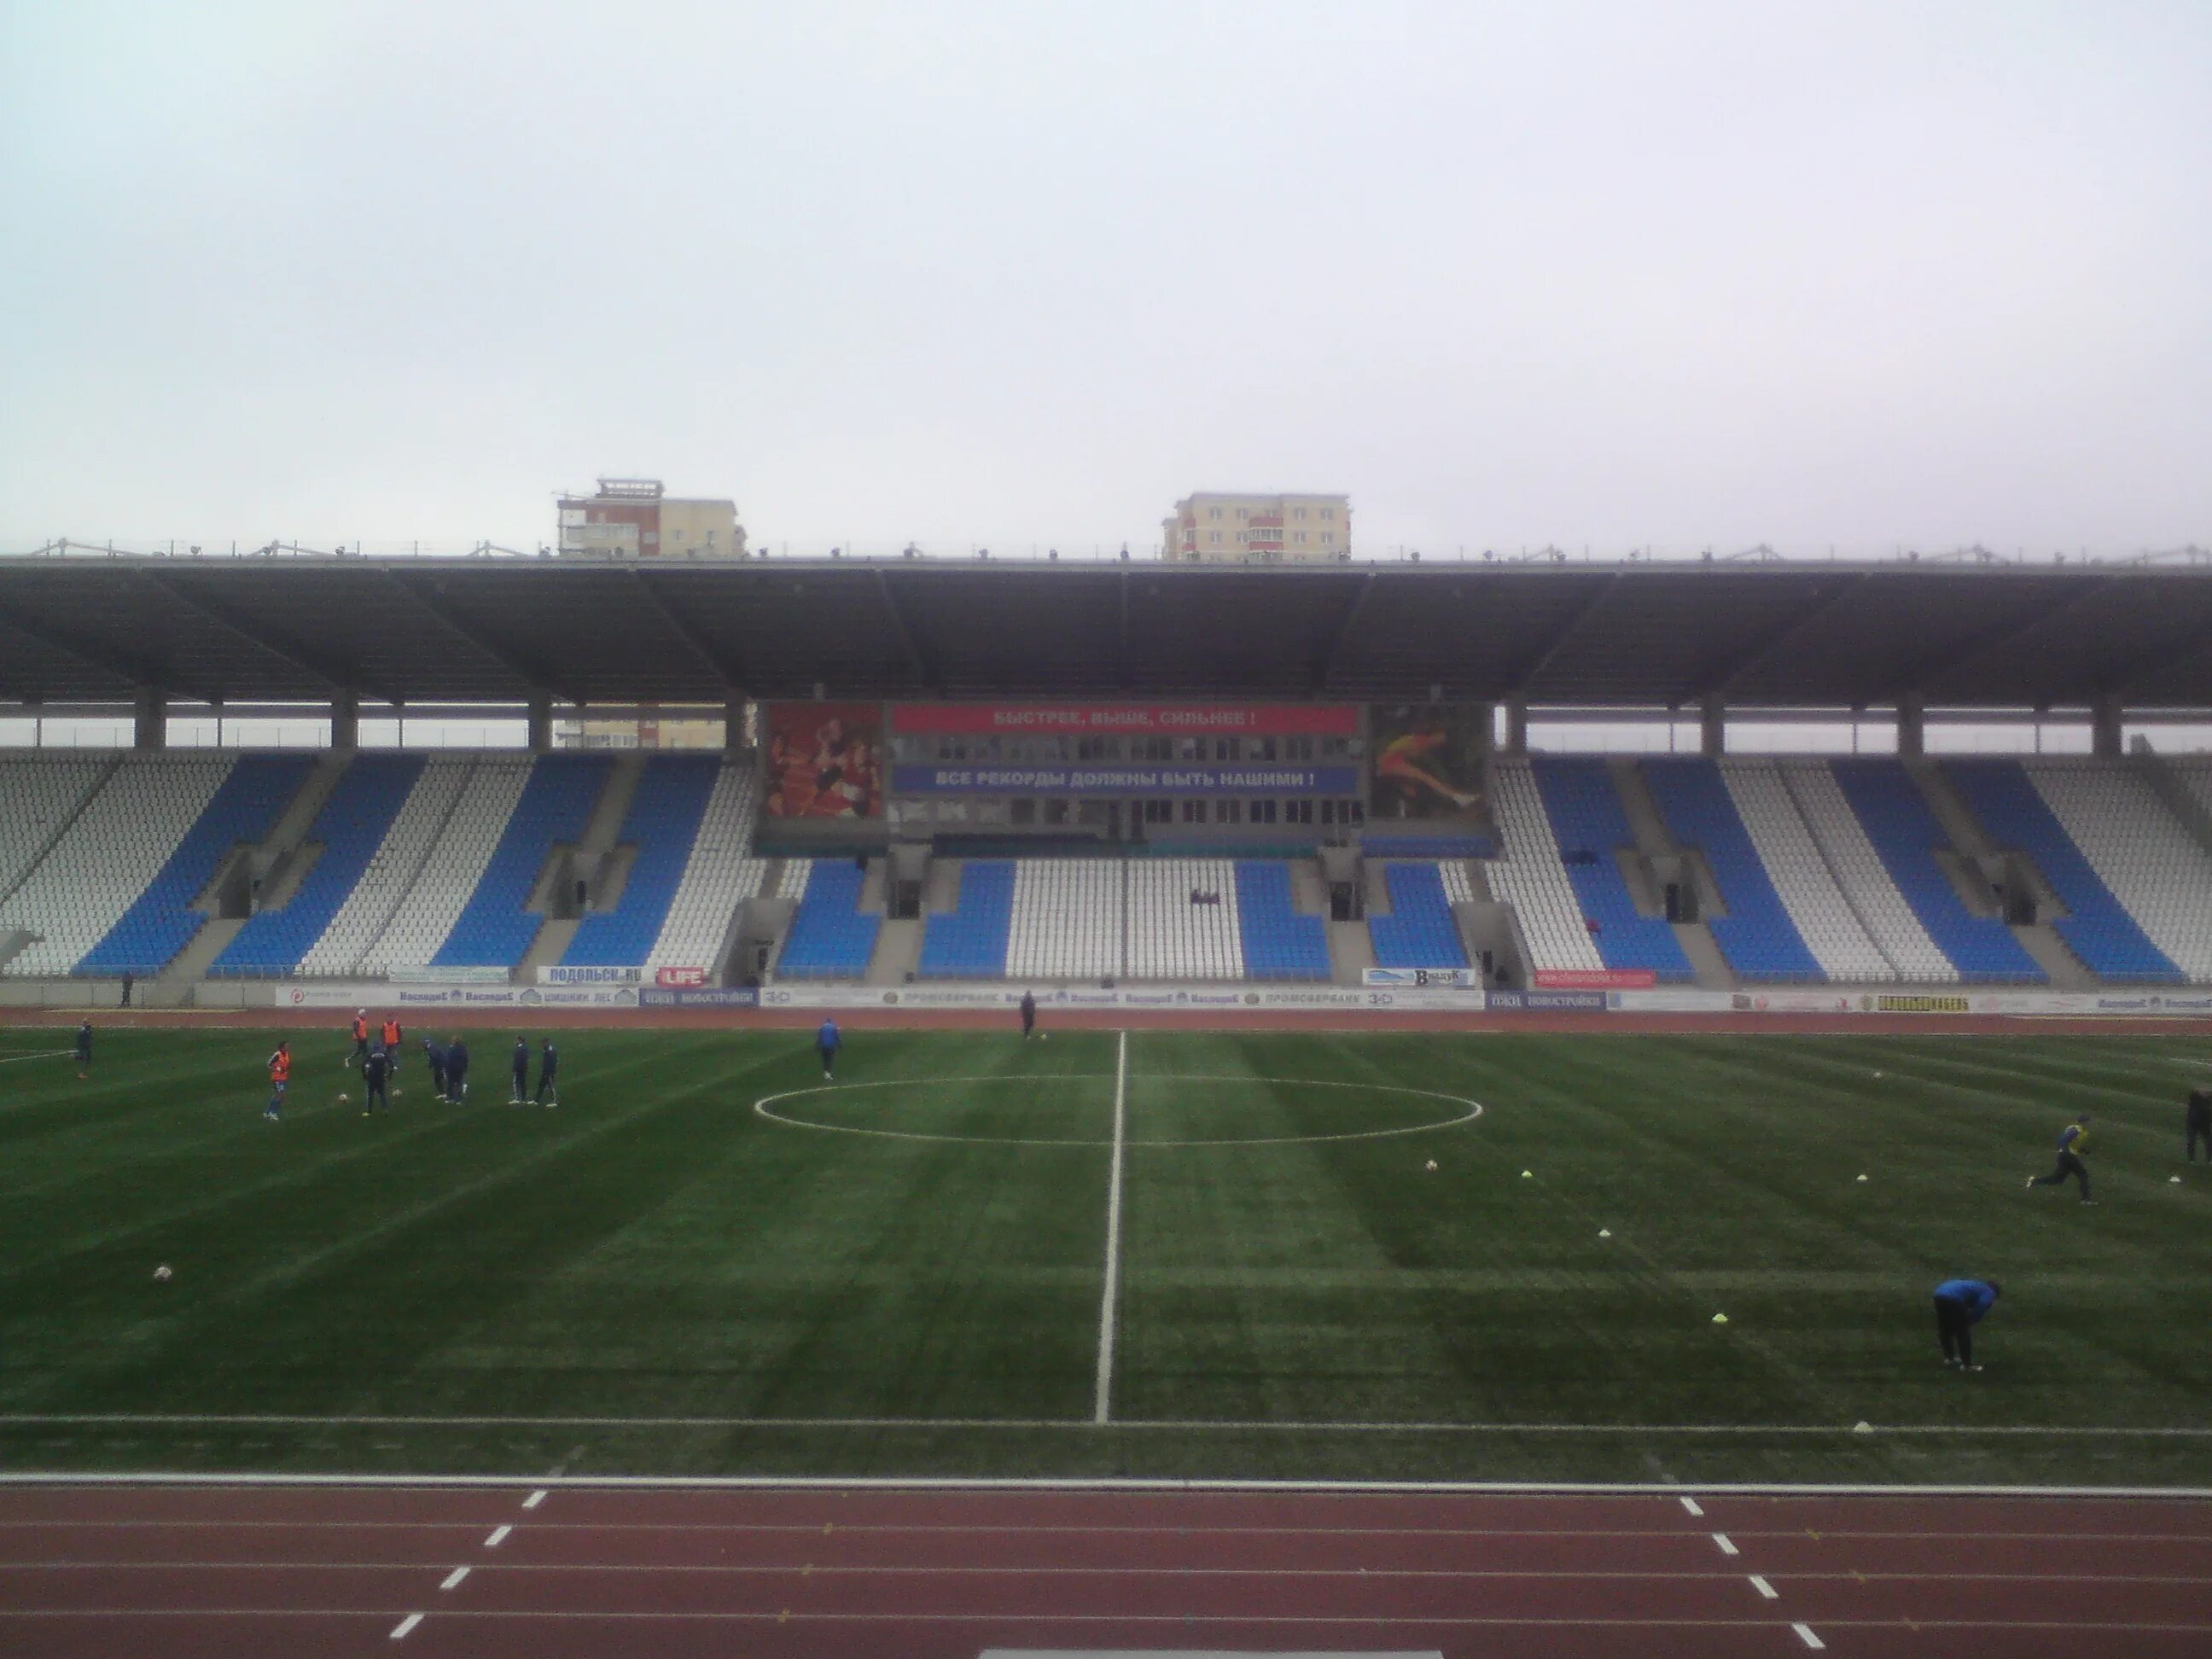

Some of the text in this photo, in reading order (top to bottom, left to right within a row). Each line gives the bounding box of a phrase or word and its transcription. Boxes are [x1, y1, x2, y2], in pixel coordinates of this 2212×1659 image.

[993, 710, 1086, 726] БЫСТРЕЕ,
[1091, 710, 1154, 726] ВЫШЕ,
[1160, 710, 1244, 725] СИЛЬНЕЕ
[935, 771, 970, 785] ВСЕ
[976, 771, 1065, 788] РЕКОРДЫ
[1069, 771, 1156, 788] ДОЛЖНЫ
[1161, 771, 1215, 786] БЫТЬ
[1220, 772, 1304, 786] НАШИМИ
